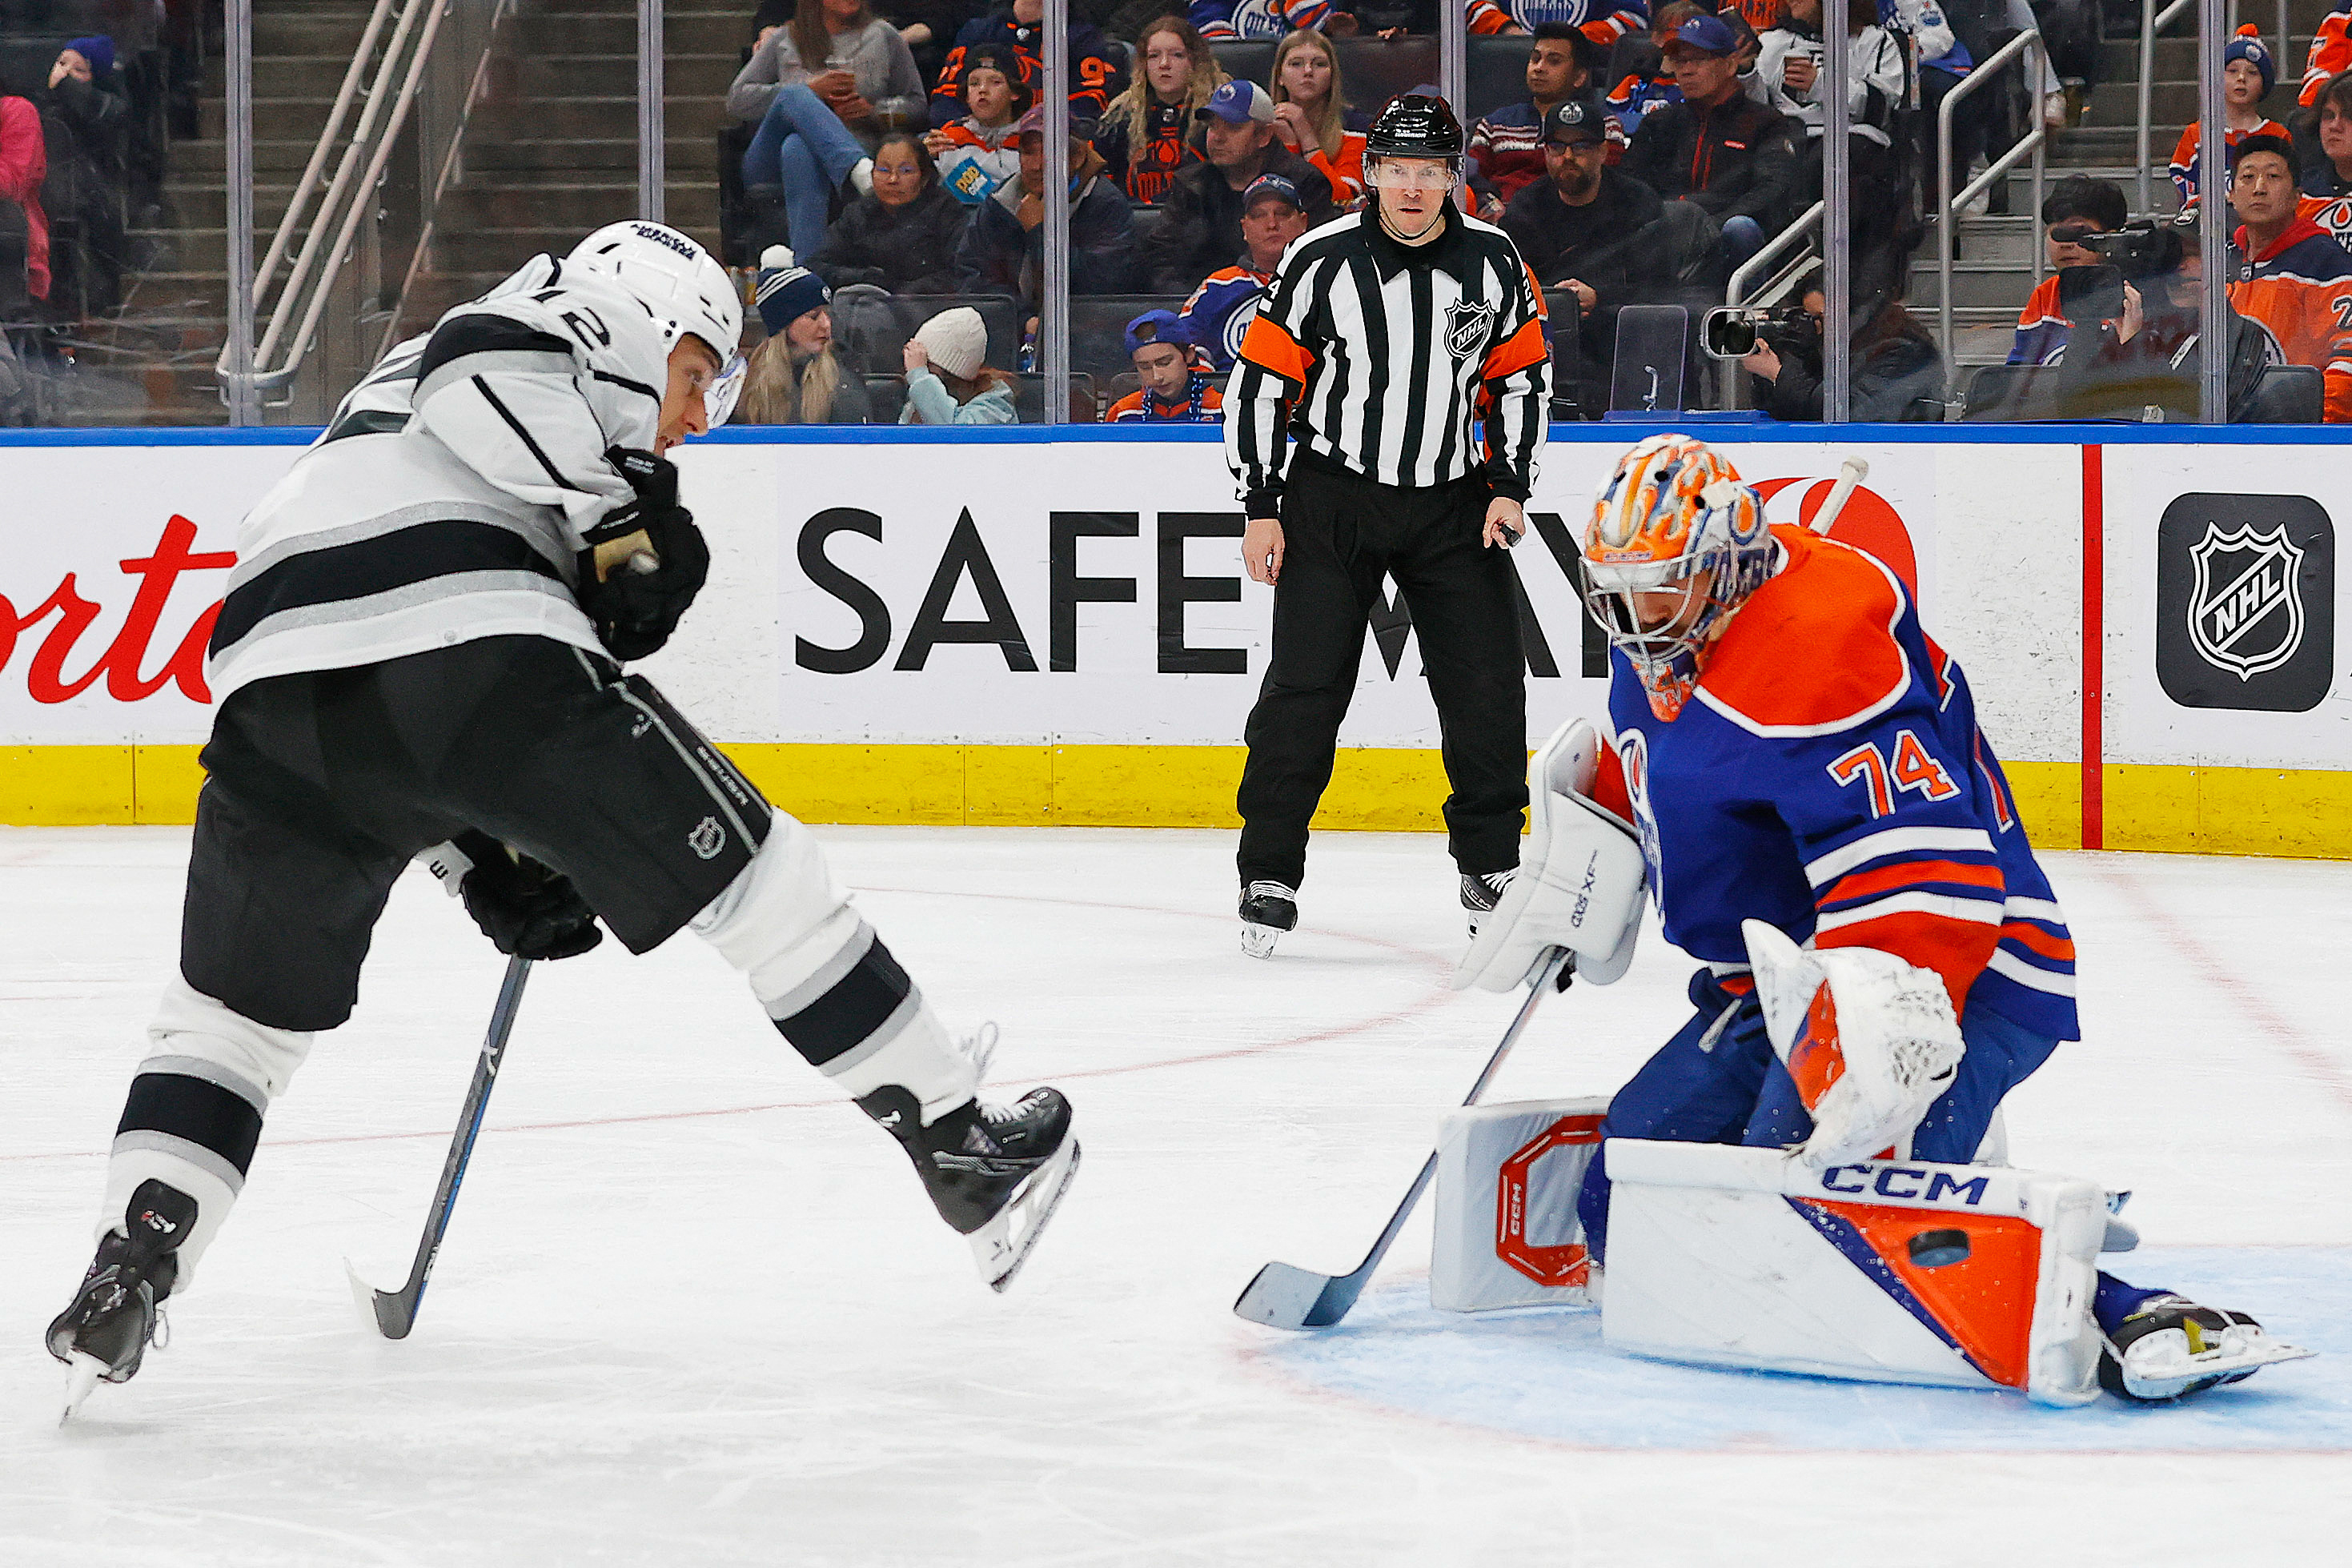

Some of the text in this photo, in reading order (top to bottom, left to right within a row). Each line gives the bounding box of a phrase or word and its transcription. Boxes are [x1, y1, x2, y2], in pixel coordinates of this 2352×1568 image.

[1267, 279, 1282, 300] 4
[1455, 317, 1486, 348] NHL
[795, 505, 1609, 679] SAFEY
[2214, 564, 2281, 643] NHL
[1825, 728, 1961, 820] 74
[1463, 879, 1492, 909] CCM
[1821, 1164, 1990, 1205] CCM
[1510, 1182, 1523, 1237] CCM
